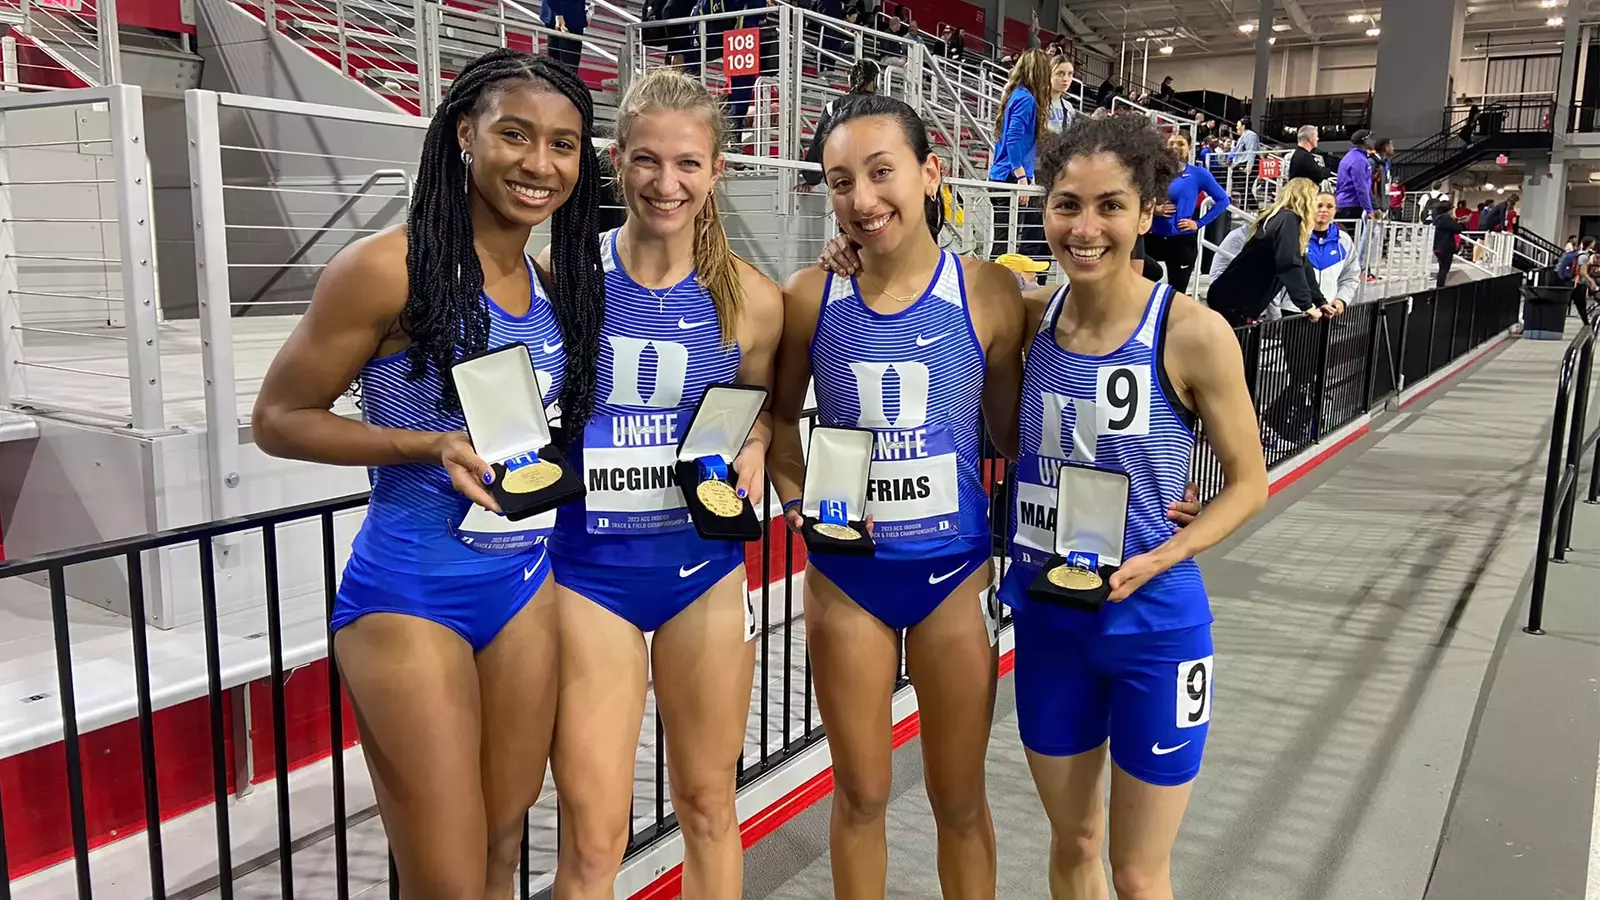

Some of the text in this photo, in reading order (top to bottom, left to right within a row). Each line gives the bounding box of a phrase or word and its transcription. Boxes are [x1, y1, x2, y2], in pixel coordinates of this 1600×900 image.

[728, 34, 754, 51] 108
[728, 54, 755, 70] 109
[1106, 368, 1138, 430] 9
[612, 413, 678, 447] UNITE
[866, 475, 931, 502] FRIAS
[647, 519, 686, 528] CHAMPIONSHIPS
[900, 527, 937, 537] CHAMPIONSHIPS
[1187, 662, 1207, 722] 9
